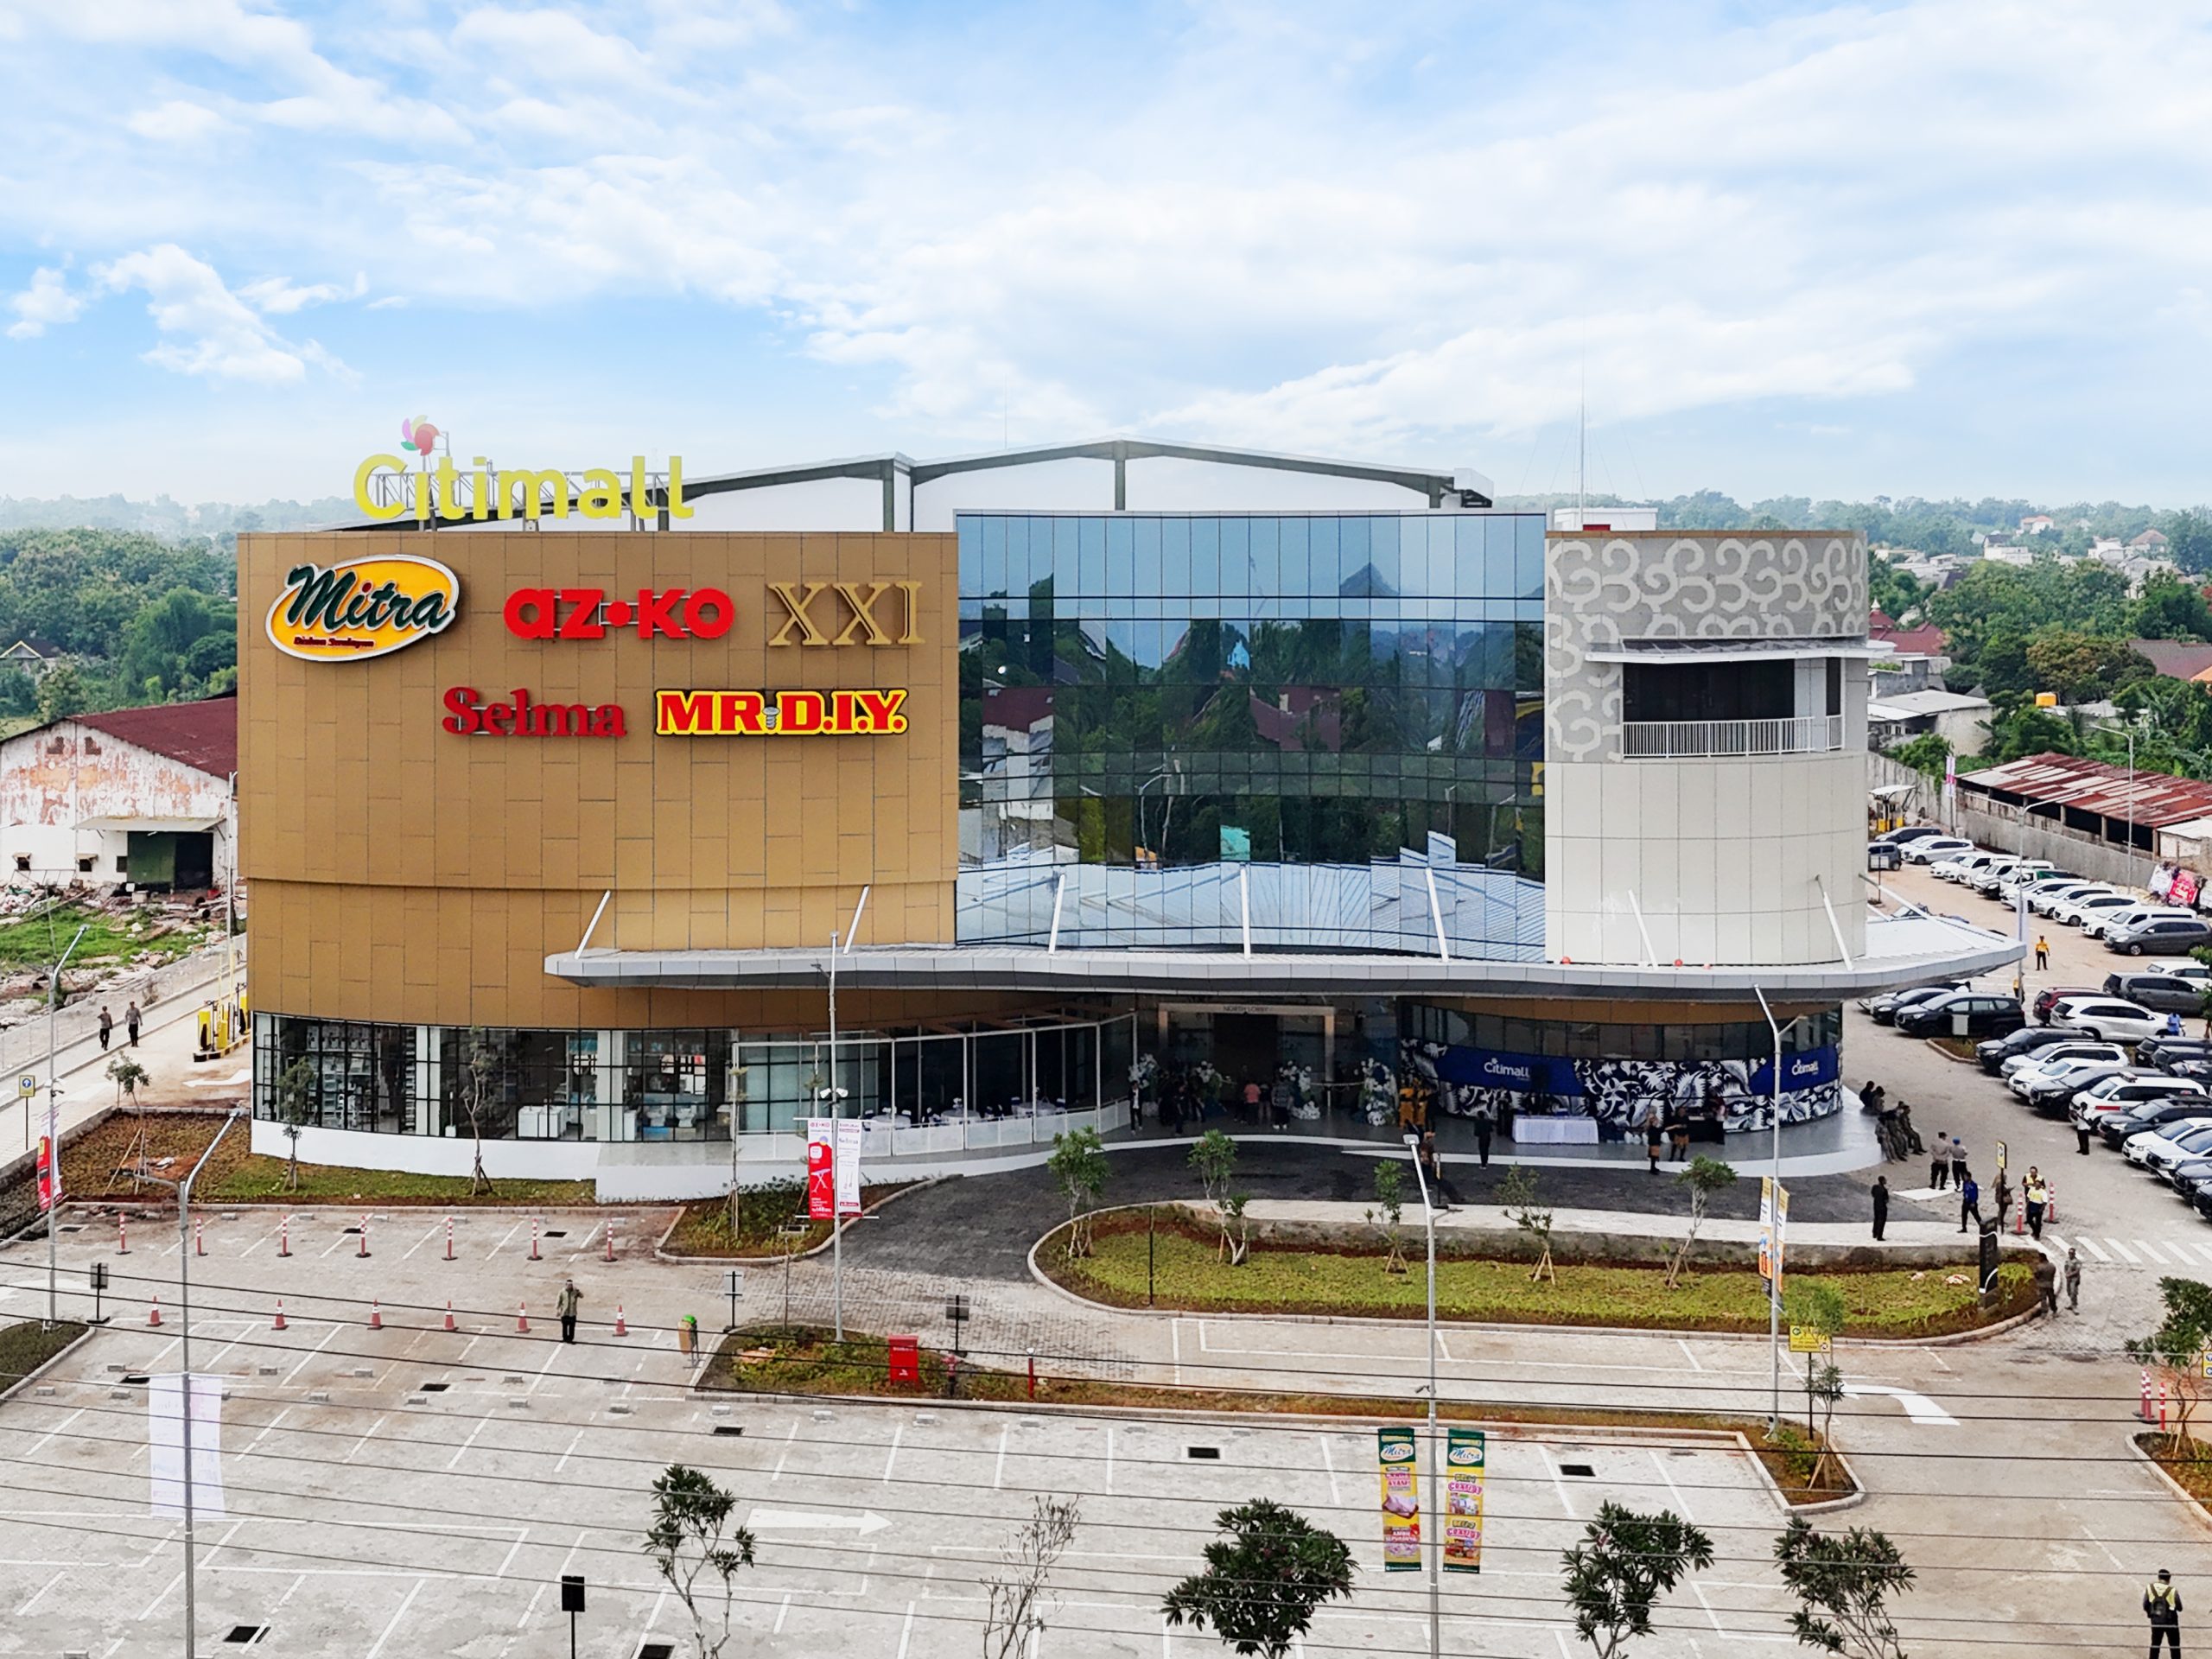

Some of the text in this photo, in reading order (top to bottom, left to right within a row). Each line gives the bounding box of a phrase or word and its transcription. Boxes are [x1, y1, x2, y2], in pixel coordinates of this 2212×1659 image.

[353, 453, 695, 520] Citimall
[287, 565, 451, 629] Mitra
[766, 581, 926, 646] XXI
[442, 686, 628, 739] Selma
[1484, 1058, 1530, 1078] Citimall
